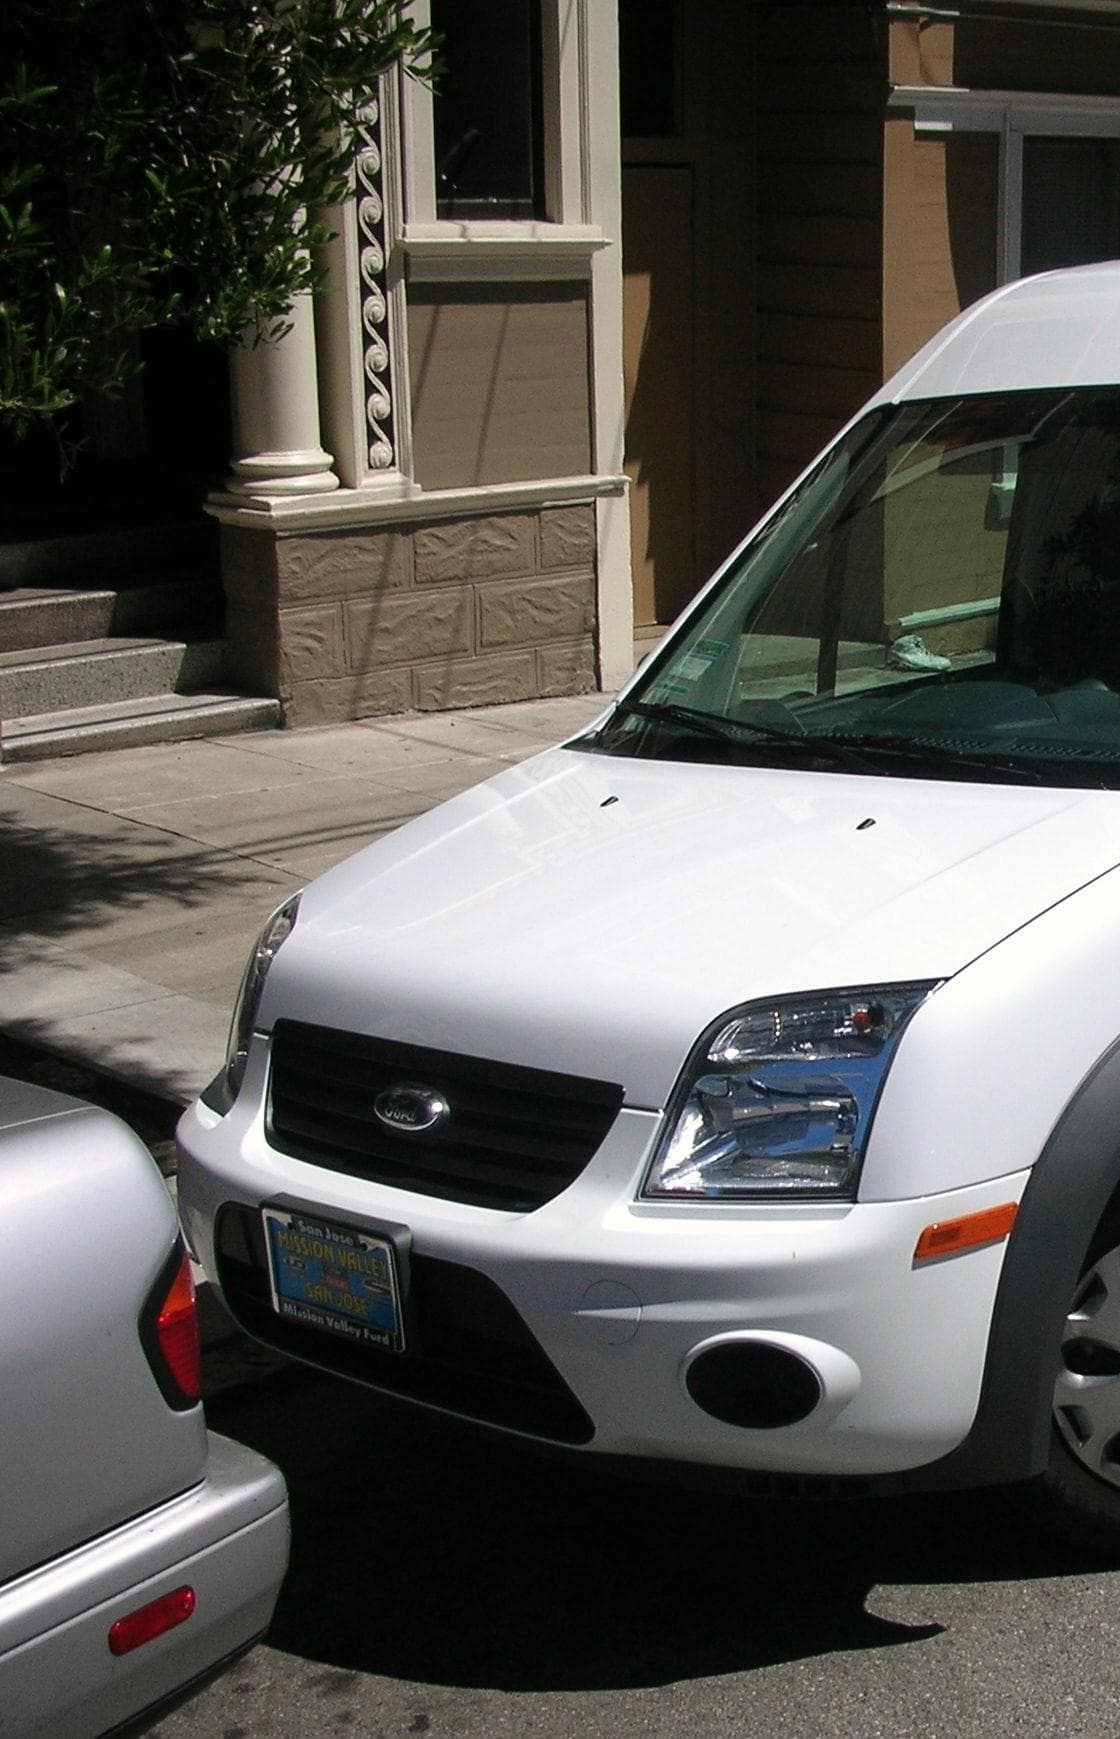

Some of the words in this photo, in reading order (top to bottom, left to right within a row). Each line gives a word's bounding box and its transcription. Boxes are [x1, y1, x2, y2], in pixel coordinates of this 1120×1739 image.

[298, 1220, 323, 1238] San
[325, 1228, 354, 1245] Jose
[278, 1231, 334, 1263] MISSION
[338, 1248, 387, 1280] VALLEY
[308, 1284, 333, 1303] SAN
[337, 1293, 369, 1315] JOSE
[283, 1303, 325, 1325] Mission
[326, 1316, 361, 1338] Valley
[364, 1328, 389, 1345] Ford
